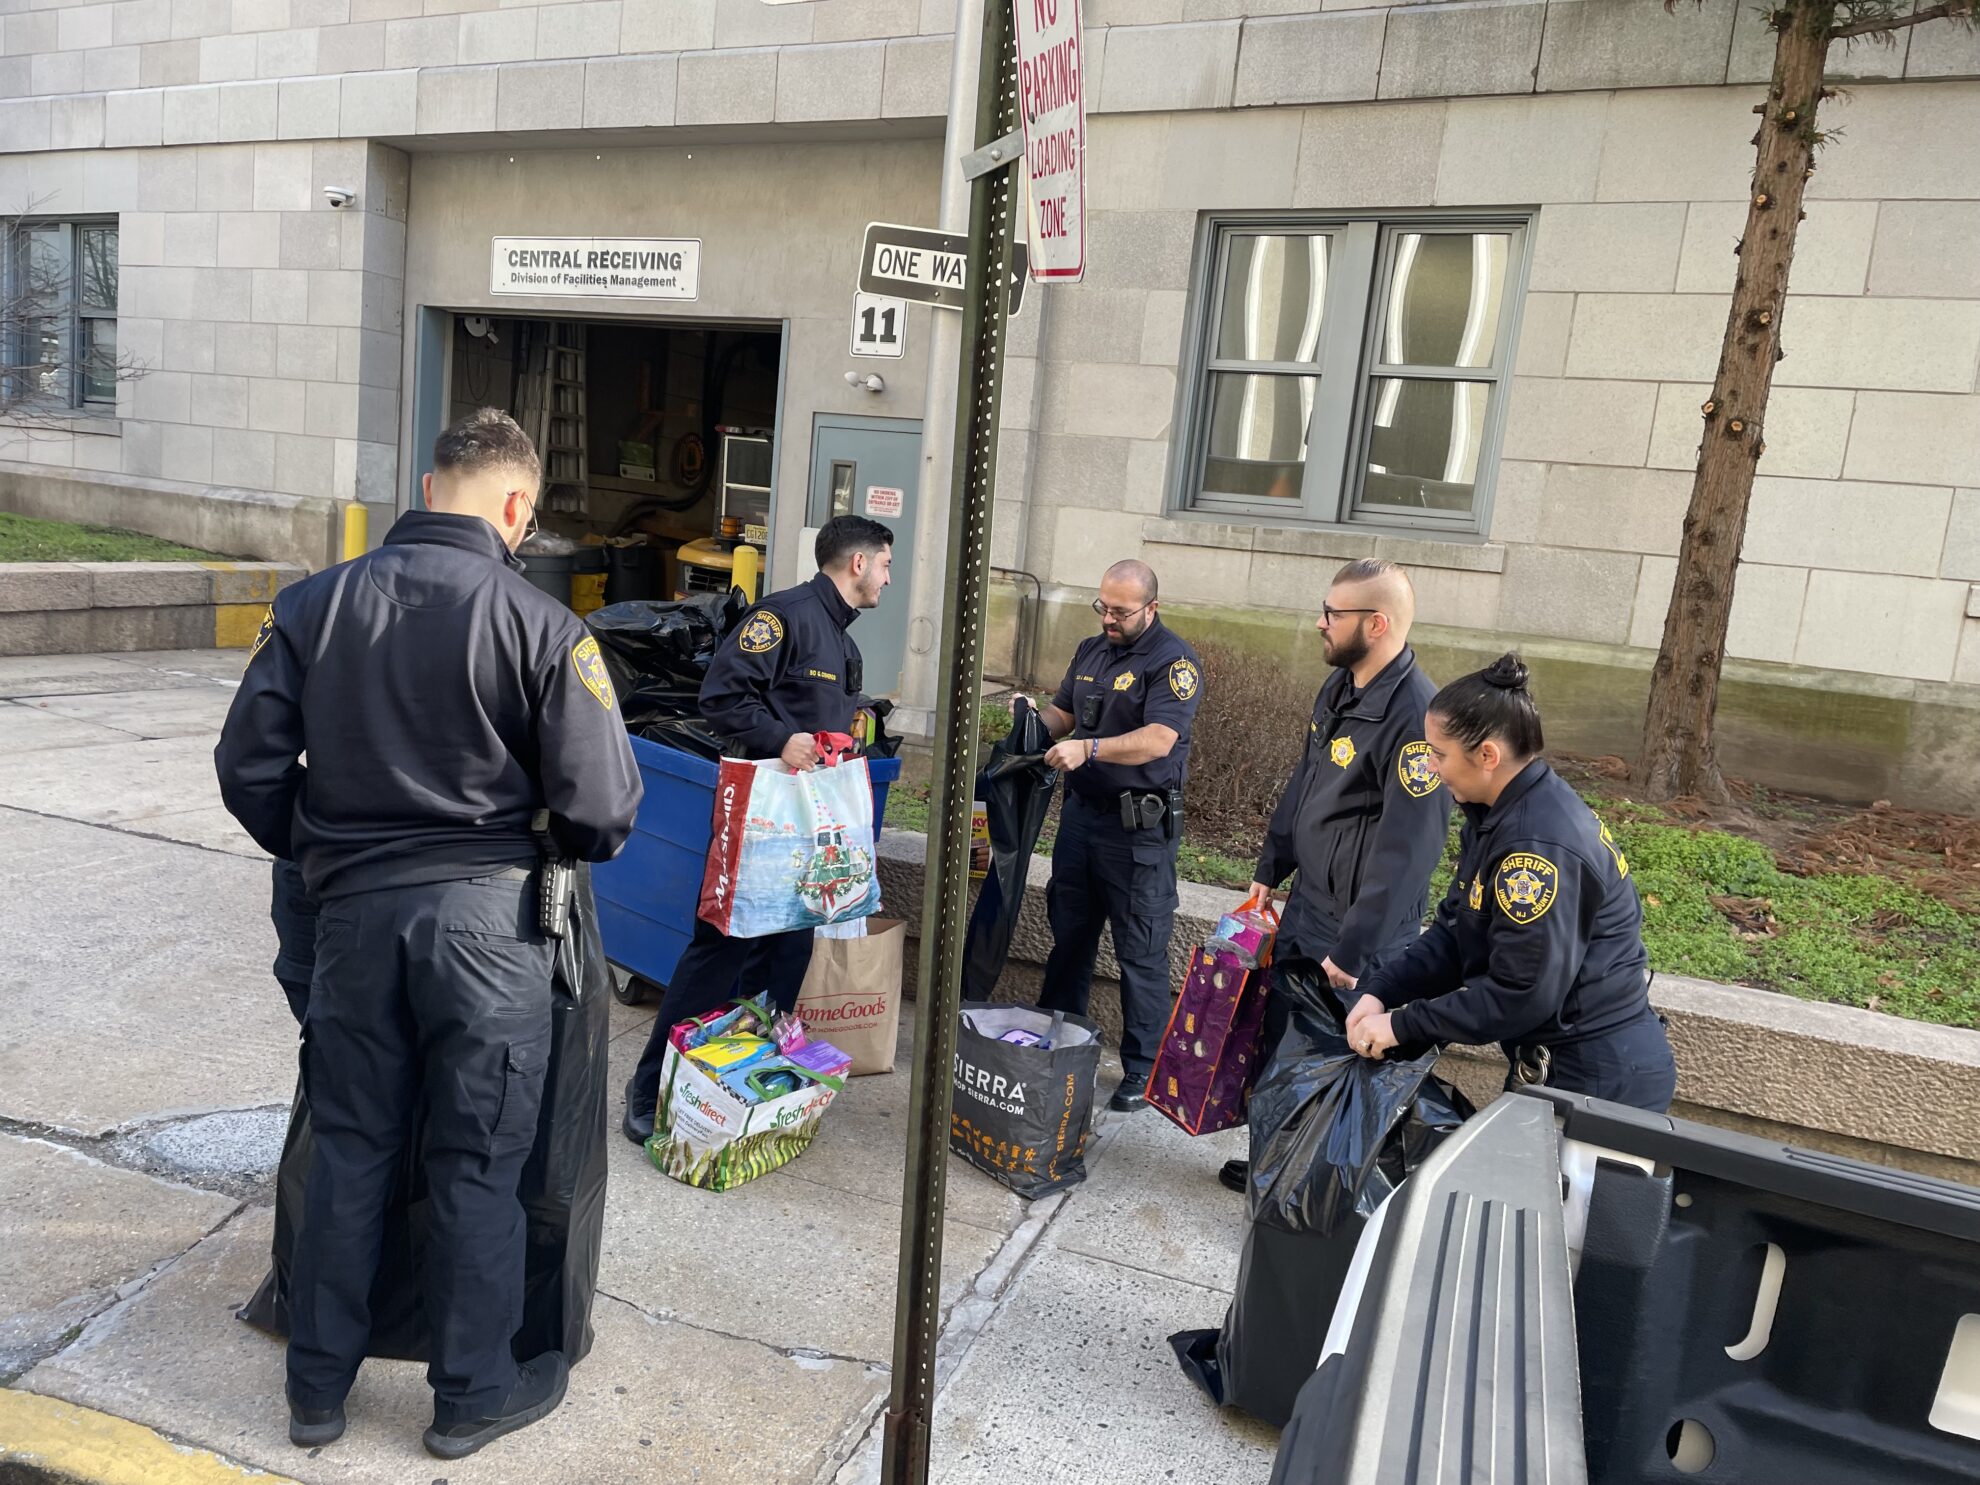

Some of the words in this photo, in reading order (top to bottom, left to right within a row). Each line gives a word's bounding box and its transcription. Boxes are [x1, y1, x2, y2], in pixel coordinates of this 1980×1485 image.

[1022, 37, 1077, 118] PARKING
[1031, 128, 1076, 180] LOADING
[1040, 196, 1067, 239] ZONE
[508, 250, 582, 269] CENTRAL
[587, 251, 682, 271] RECEIVING
[879, 248, 921, 278] ONE
[932, 255, 966, 285] WA
[510, 272, 548, 284] Division
[550, 273, 562, 284] of
[563, 274, 608, 286] Facilities
[610, 274, 677, 289] Management
[860, 307, 897, 343] 11
[757, 613, 781, 638] SHERIFF
[1502, 857, 1553, 876] SHERIFF
[1498, 888, 1513, 911] UNION
[1531, 888, 1553, 914] COUNTY
[1516, 910, 1527, 918] NJ
[681, 1083, 727, 1128] freshdirect
[967, 1087, 1025, 1116] SIERRA.COM
